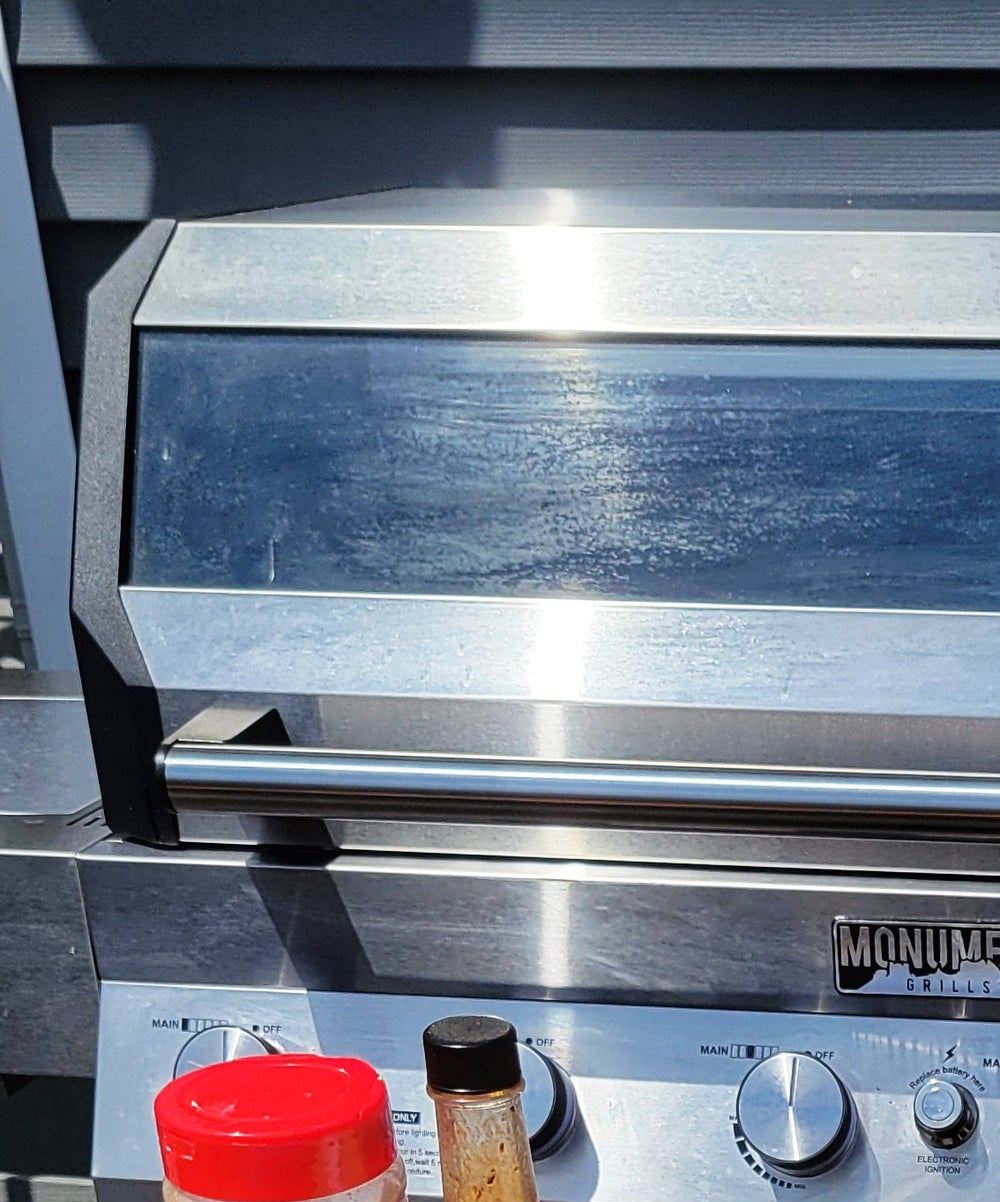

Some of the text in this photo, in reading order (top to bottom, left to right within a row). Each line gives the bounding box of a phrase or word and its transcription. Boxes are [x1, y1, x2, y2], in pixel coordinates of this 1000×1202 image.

[906, 978, 991, 994] GRILLS
[152, 1019, 180, 1029] MAIN
[262, 1025, 282, 1034] OFF
[536, 1038, 555, 1047] OFF
[700, 1045, 729, 1056] MAIN
[815, 1051, 835, 1060] OFF
[909, 1066, 985, 1092] Replace battery here
[393, 1112, 418, 1122] ONLY
[917, 1156, 970, 1165] ELECTRONIC
[924, 1166, 961, 1175] IGNITION
